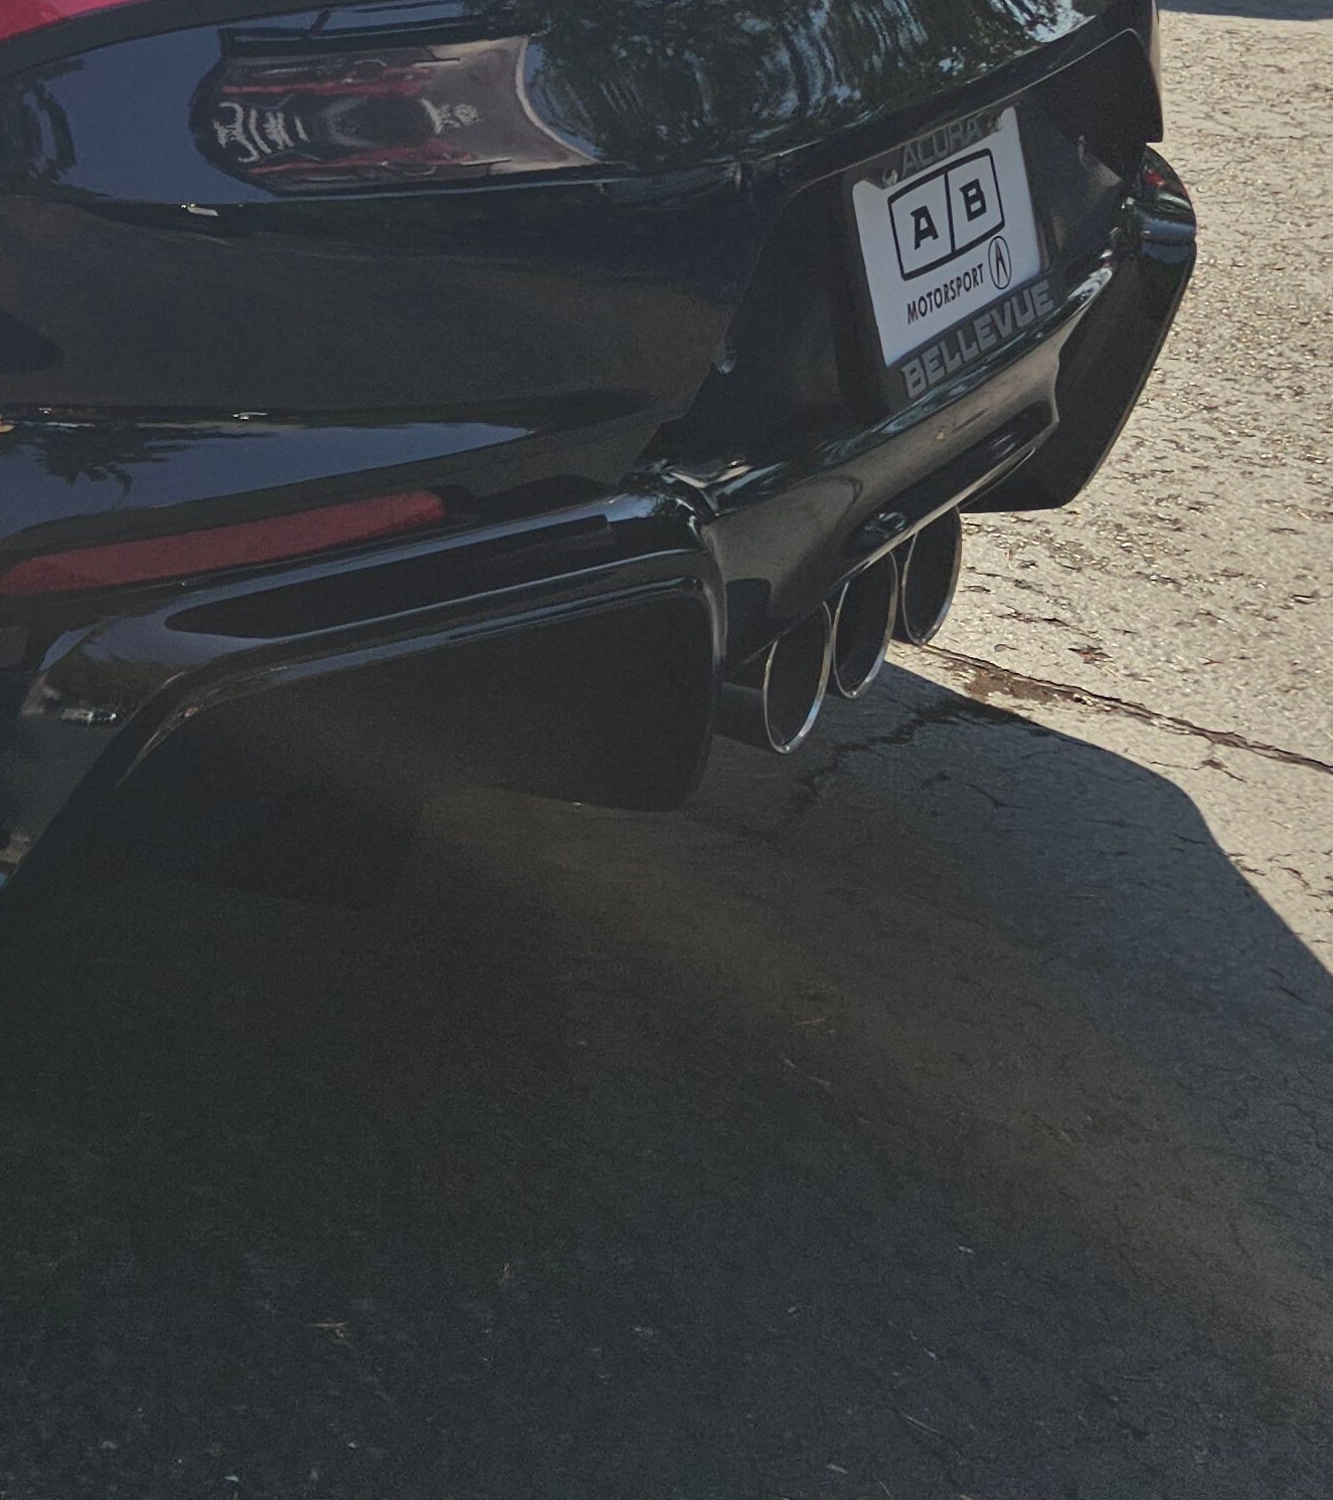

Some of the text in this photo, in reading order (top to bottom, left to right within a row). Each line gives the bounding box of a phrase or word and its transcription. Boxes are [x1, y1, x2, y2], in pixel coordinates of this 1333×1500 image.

[901, 116, 983, 179] ACURA
[909, 178, 987, 250] A B
[906, 263, 985, 325] MOTORSPORT
[899, 279, 1055, 399] BELLEVUE
